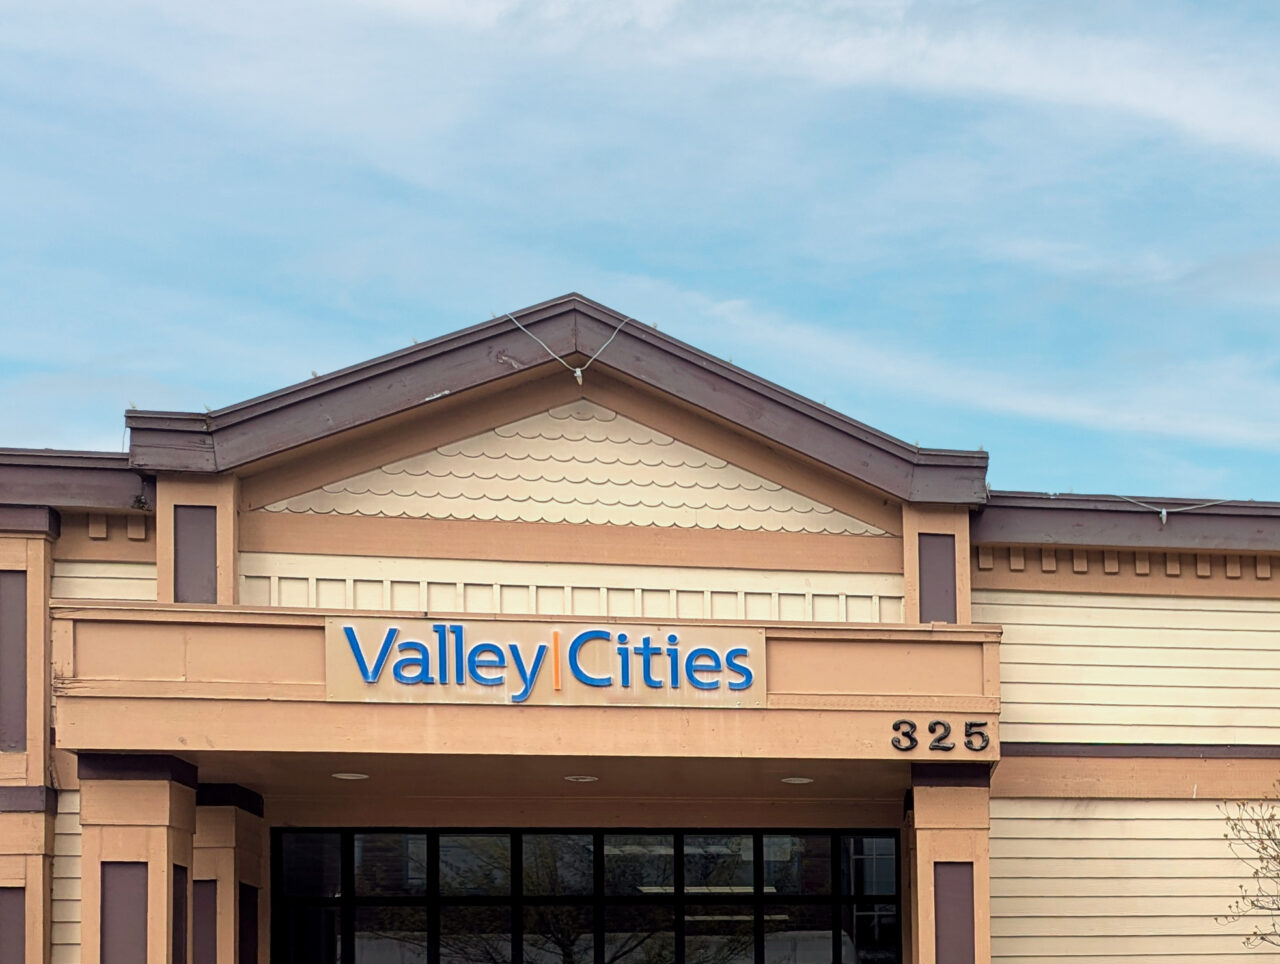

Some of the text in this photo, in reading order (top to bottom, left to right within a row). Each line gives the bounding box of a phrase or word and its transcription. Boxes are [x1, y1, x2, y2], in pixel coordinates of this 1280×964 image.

[343, 624, 755, 702] Valley Cities
[891, 719, 990, 752] 325
